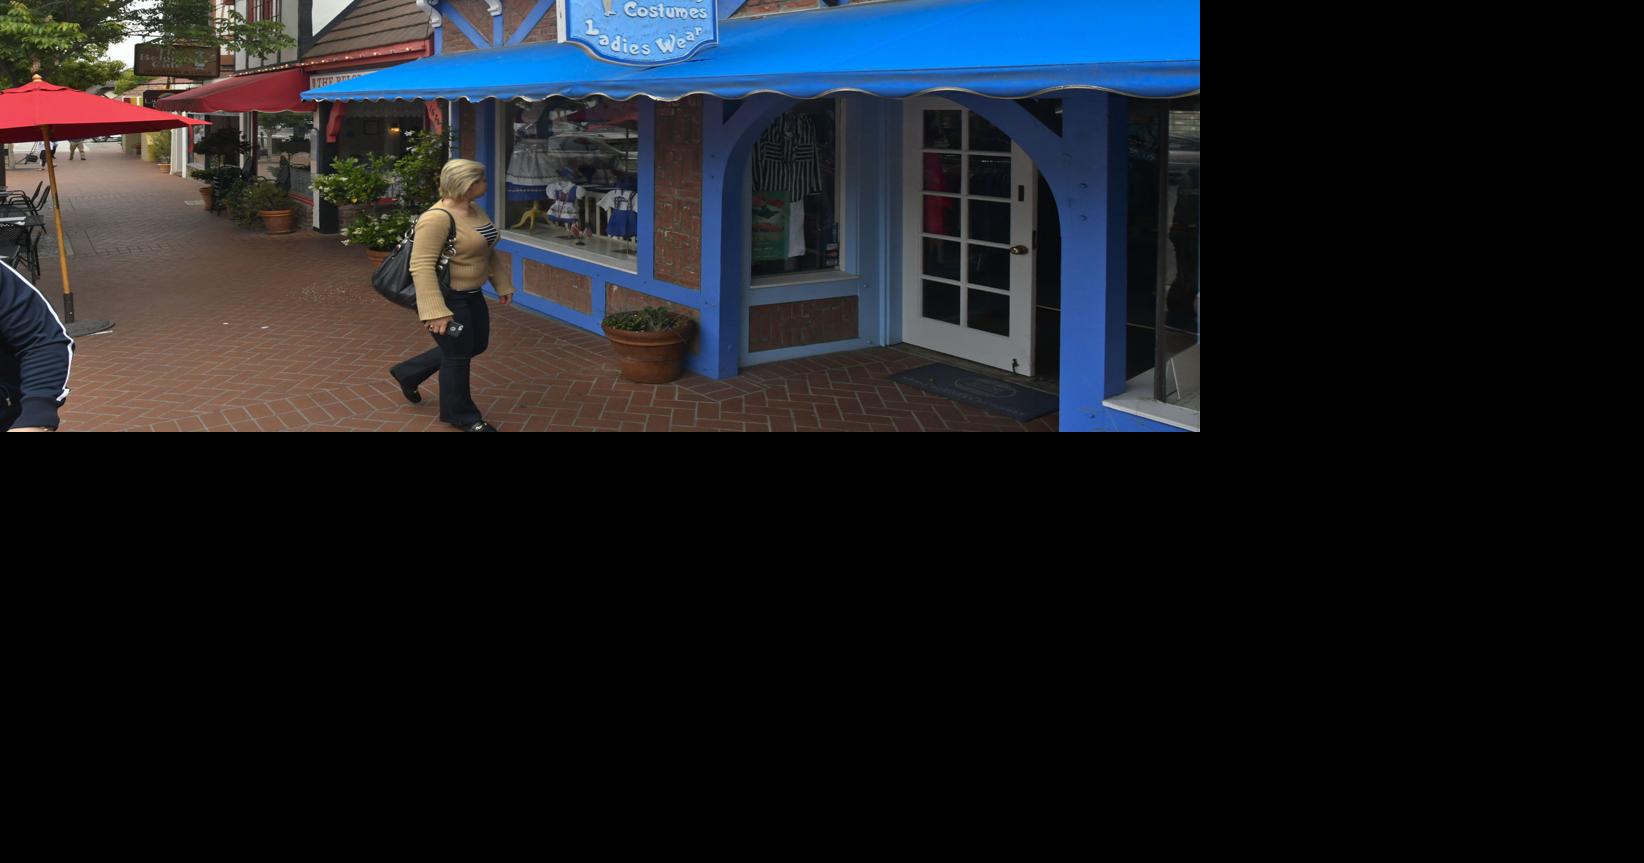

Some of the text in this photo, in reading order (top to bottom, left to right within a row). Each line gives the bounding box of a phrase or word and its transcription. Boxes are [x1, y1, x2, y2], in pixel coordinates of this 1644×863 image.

[623, 1, 708, 19] Costumes
[584, 19, 703, 55] Ladies Wear
